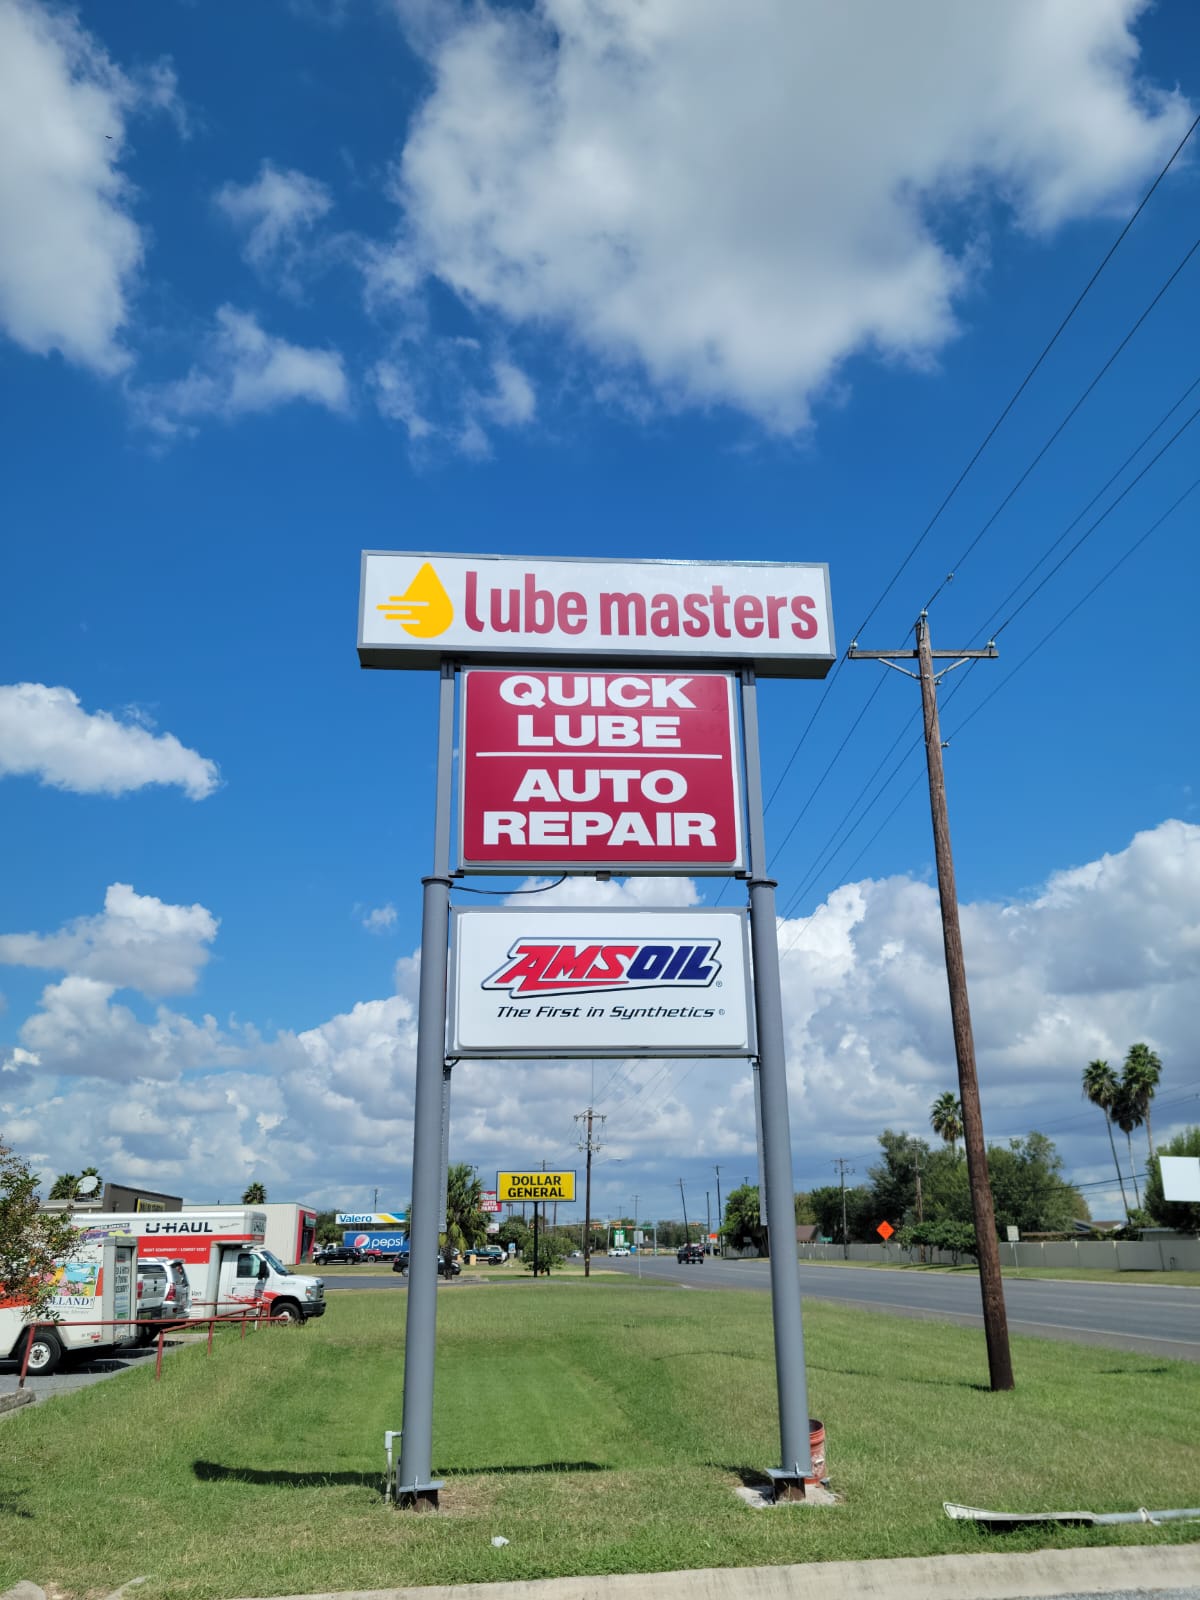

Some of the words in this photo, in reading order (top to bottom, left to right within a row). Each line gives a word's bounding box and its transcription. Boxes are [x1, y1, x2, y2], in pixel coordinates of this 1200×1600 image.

[464, 570, 587, 635] lube
[599, 585, 819, 640] masters
[499, 674, 697, 710] QUICK
[517, 714, 681, 748] LUBE
[513, 769, 688, 803] AUTO
[483, 811, 716, 847] REPAIR
[495, 944, 713, 992] AMSOIL
[497, 1006, 529, 1018] The
[535, 1006, 582, 1018] First
[586, 1006, 605, 1018] in
[609, 1006, 715, 1020] Synthetics
[508, 1187, 565, 1198] GENERAL
[511, 1175, 562, 1186] DOLLAR
[145, 1222, 213, 1233] U-HAUL
[339, 1214, 372, 1223] Valero
[371, 1237, 404, 1249] pepsi
